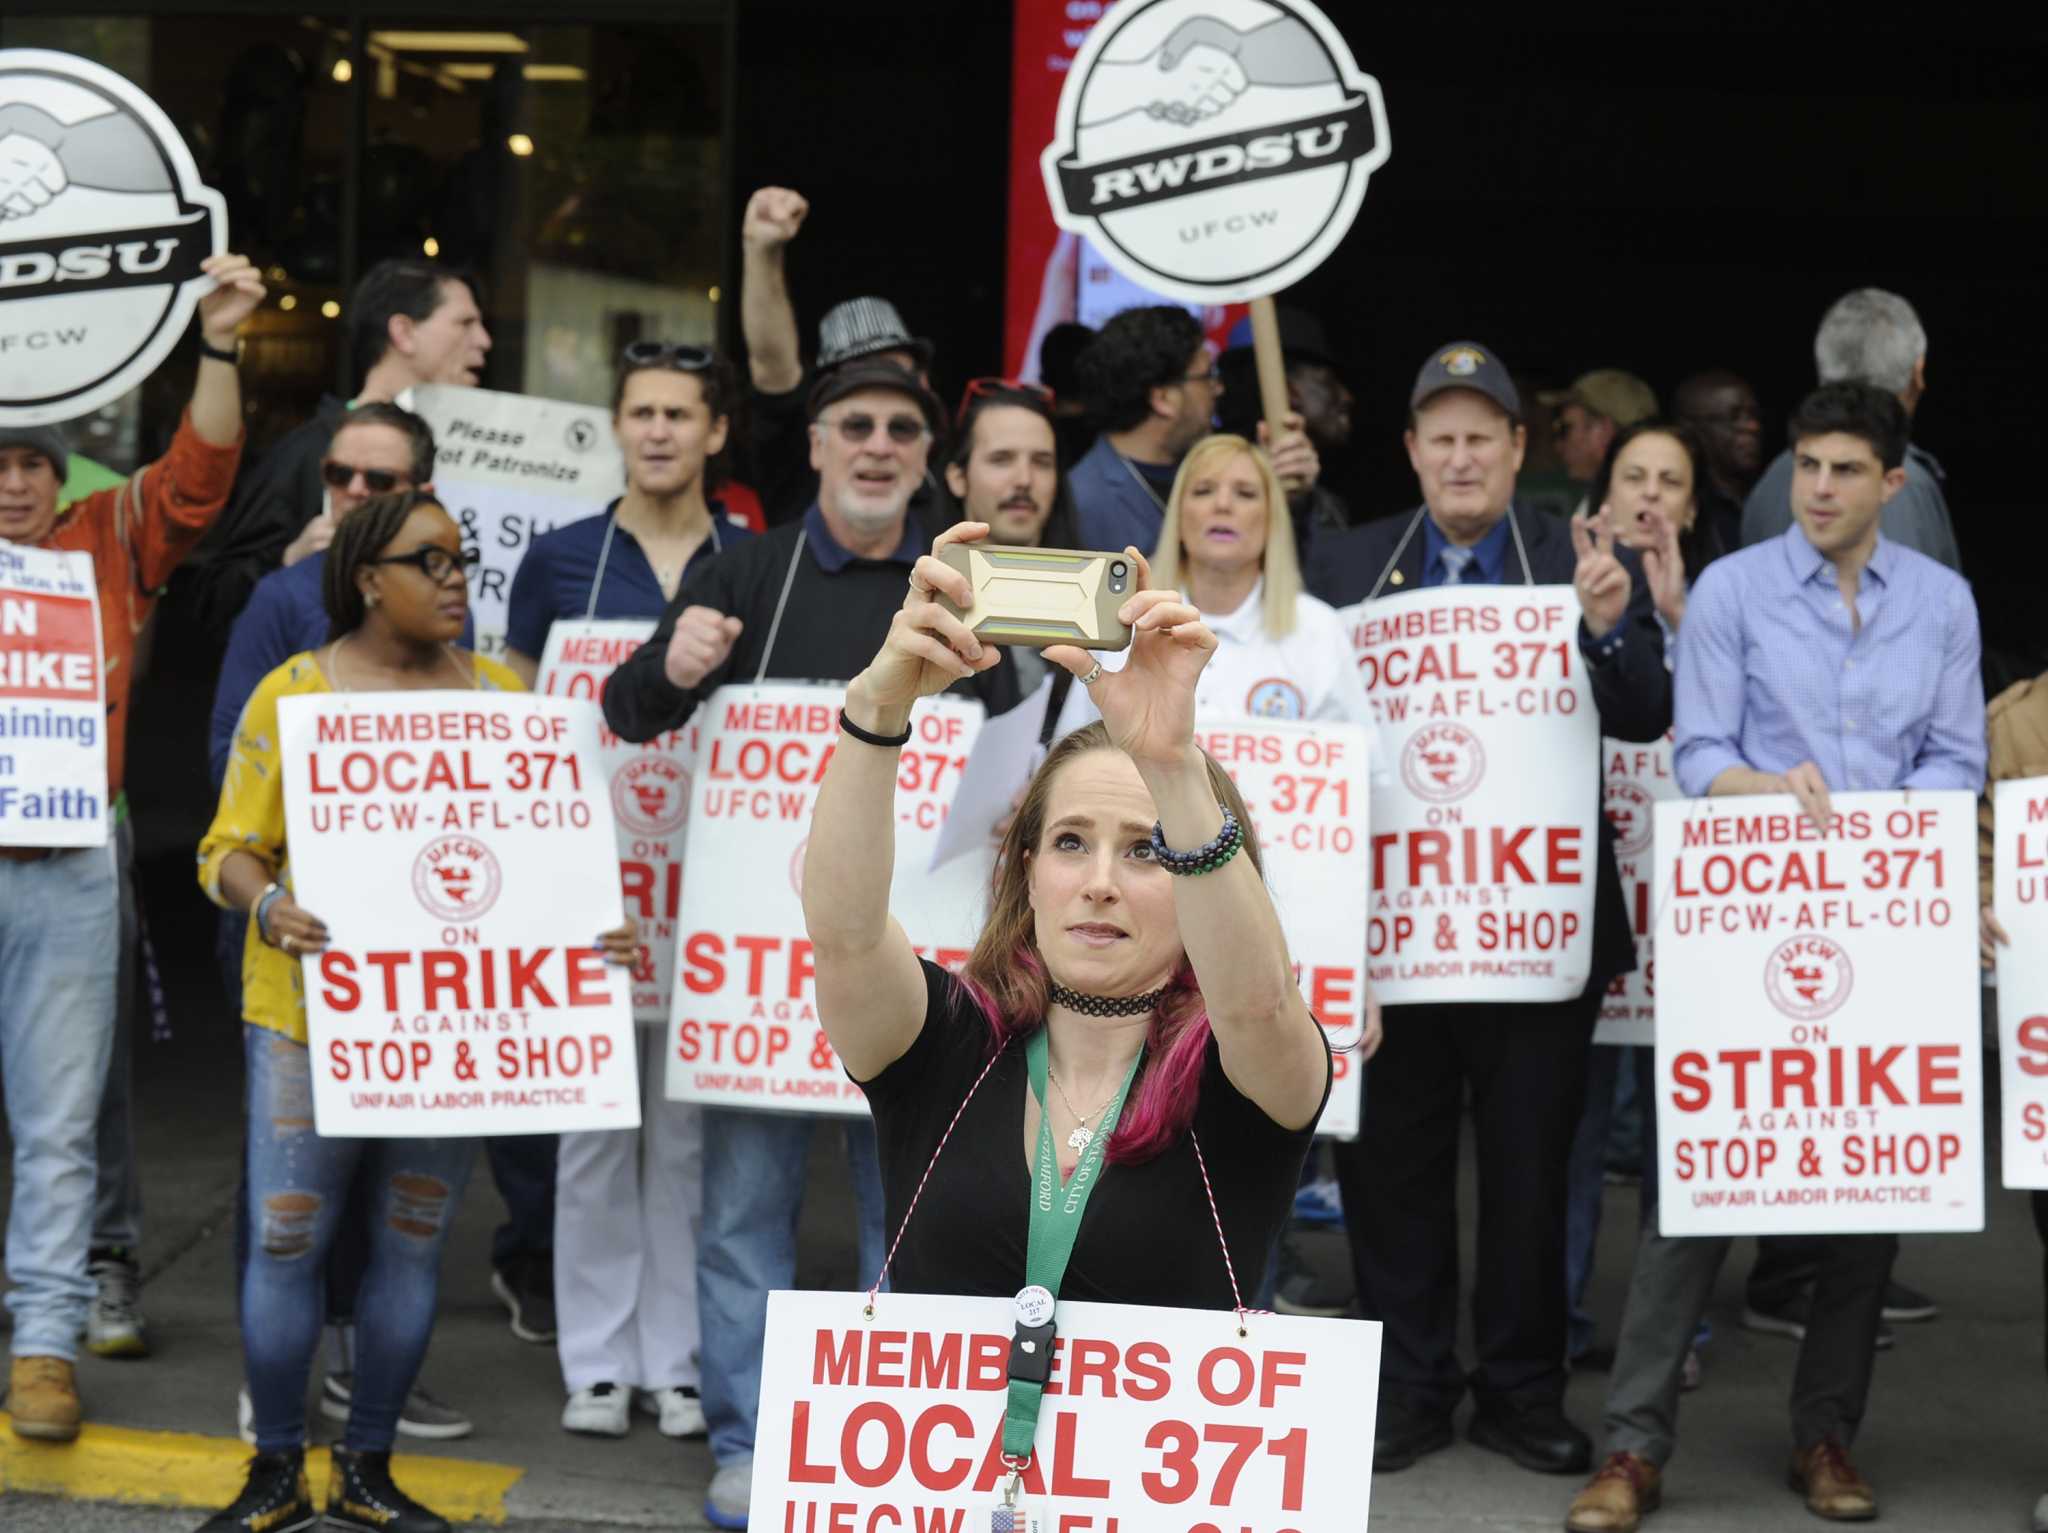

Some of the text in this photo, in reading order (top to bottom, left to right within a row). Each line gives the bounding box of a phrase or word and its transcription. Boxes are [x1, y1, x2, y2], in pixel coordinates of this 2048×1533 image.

[1090, 121, 1348, 205] RWDSU
[1179, 209, 1280, 244] UFCW
[0, 238, 180, 288] DSU
[1, 327, 87, 351] FCW
[448, 419, 525, 446] Please
[437, 449, 580, 482] ot Patronize
[3, 600, 37, 636] N
[1514, 607, 1562, 632] OF
[1359, 641, 1569, 692] OCAL 371
[1370, 687, 1578, 723] W-AFL-CIO
[0, 707, 96, 746] ining
[317, 712, 512, 743] MEMBERS
[523, 715, 565, 742] OF
[725, 704, 960, 745] MEMB OF
[1296, 738, 1344, 768] OF
[309, 751, 581, 794] LOCAL 371
[1271, 773, 1348, 817] 371
[311, 800, 591, 832] UFCW-AFL-CIO
[1426, 807, 1462, 825] ON
[1682, 810, 1936, 848] MEMBERS OF
[427, 841, 485, 863] UFCW
[633, 841, 669, 857] ON
[1371, 827, 1582, 890] TRIKE
[1675, 848, 1944, 897] LOCAL 371
[1377, 887, 1512, 909] AGAINST
[1367, 912, 1579, 955] OP & SHOP
[1674, 898, 1951, 935] UFCW-AFL-CIO
[442, 927, 479, 945] ON
[1780, 942, 1836, 963] UFCW
[320, 947, 610, 1012] STRIKE
[1400, 962, 1463, 979] LABOR
[1472, 960, 1552, 976] PRACTICE
[392, 1012, 531, 1034] AGAINST
[1792, 1024, 1829, 1042] ON
[330, 1035, 612, 1082] STOP & SHOP
[679, 1019, 833, 1070] STOP &
[696, 1075, 765, 1093] UNFAIR
[773, 1080, 838, 1096] LABOR
[1673, 1045, 1962, 1113] STRIKE
[353, 1086, 584, 1110] UNFAIR LABOR PRACTICE
[1737, 1110, 1880, 1131] AGAINST
[1676, 1133, 1961, 1181] STOP & SHOP
[1063, 1185, 1084, 1214] CITY
[1692, 1185, 1930, 1208] UNFAIR LABOR PRACTICE
[1020, 1299, 1046, 1310] LOCAL
[1197, 1347, 1306, 1408] OF
[1142, 1420, 1307, 1511] 371
